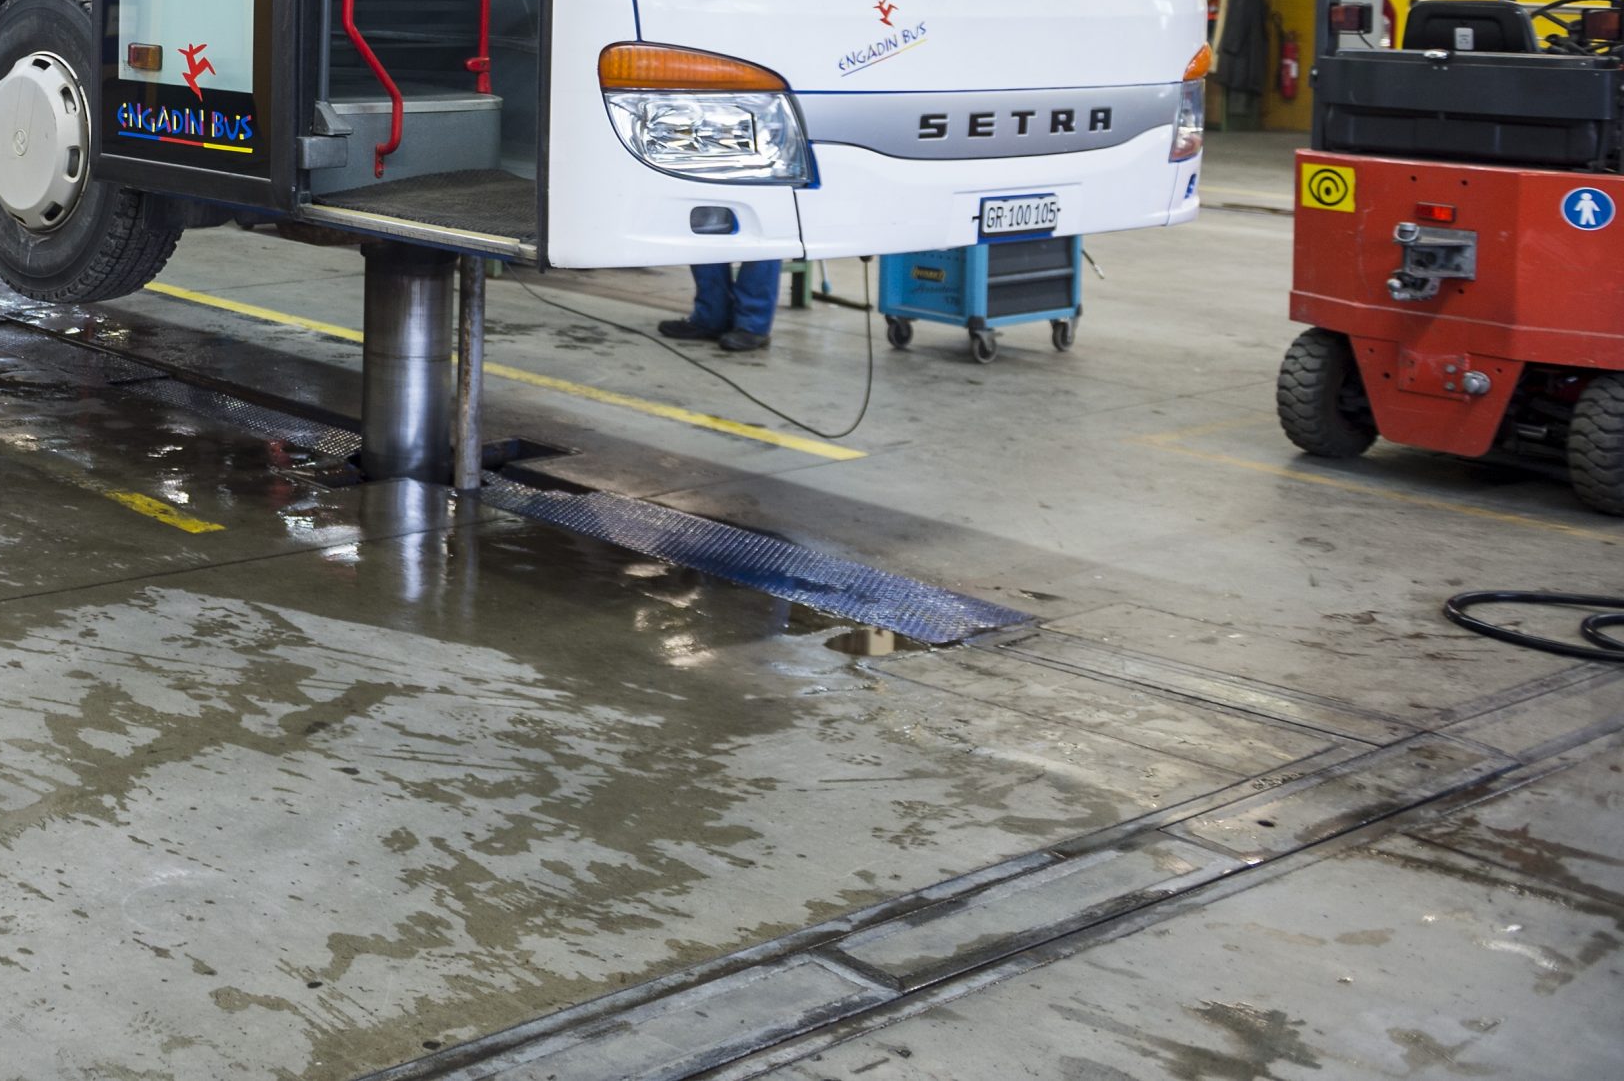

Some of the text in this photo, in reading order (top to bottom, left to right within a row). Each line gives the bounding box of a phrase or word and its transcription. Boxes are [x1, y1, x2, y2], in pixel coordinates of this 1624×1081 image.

[839, 21, 927, 71] ENGADIN BUS
[117, 103, 252, 140] ENGADIN BUS
[918, 107, 1113, 139] SETRA
